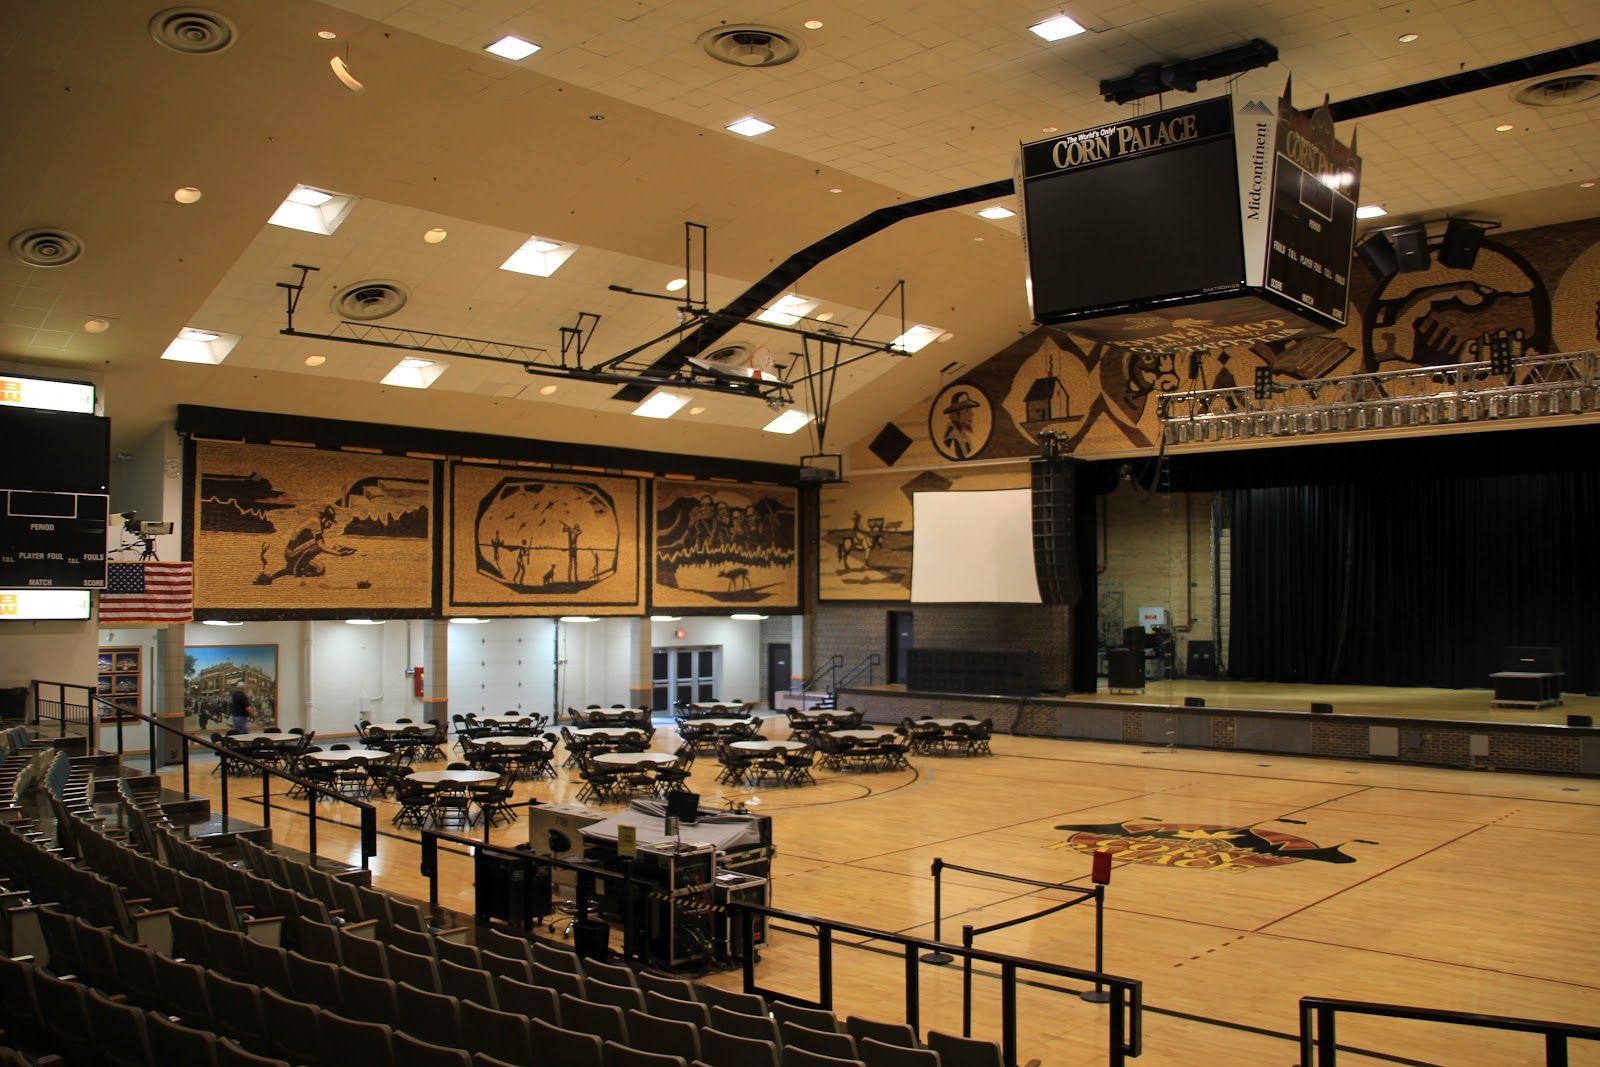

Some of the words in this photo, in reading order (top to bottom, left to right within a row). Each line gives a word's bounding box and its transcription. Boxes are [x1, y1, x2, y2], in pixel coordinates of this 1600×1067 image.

[1052, 135, 1111, 169] CORN
[1116, 114, 1198, 155] PALACE
[1066, 134, 1078, 144] The
[1078, 130, 1100, 142] World's
[1099, 126, 1117, 138] Only!
[1247, 122, 1267, 220] Midcontinent
[1309, 219, 1321, 232] PERIOD
[1273, 240, 1286, 254] FOULS
[1270, 278, 1283, 291] SCORE
[1203, 319, 1285, 334] CORN
[30, 523, 55, 531] PERIOD
[18, 552, 45, 560] PLAYER
[47, 552, 64, 560] FOUL
[83, 553, 105, 561] FOULS
[28, 578, 53, 586] MATCH
[83, 579, 105, 587] SCORE
